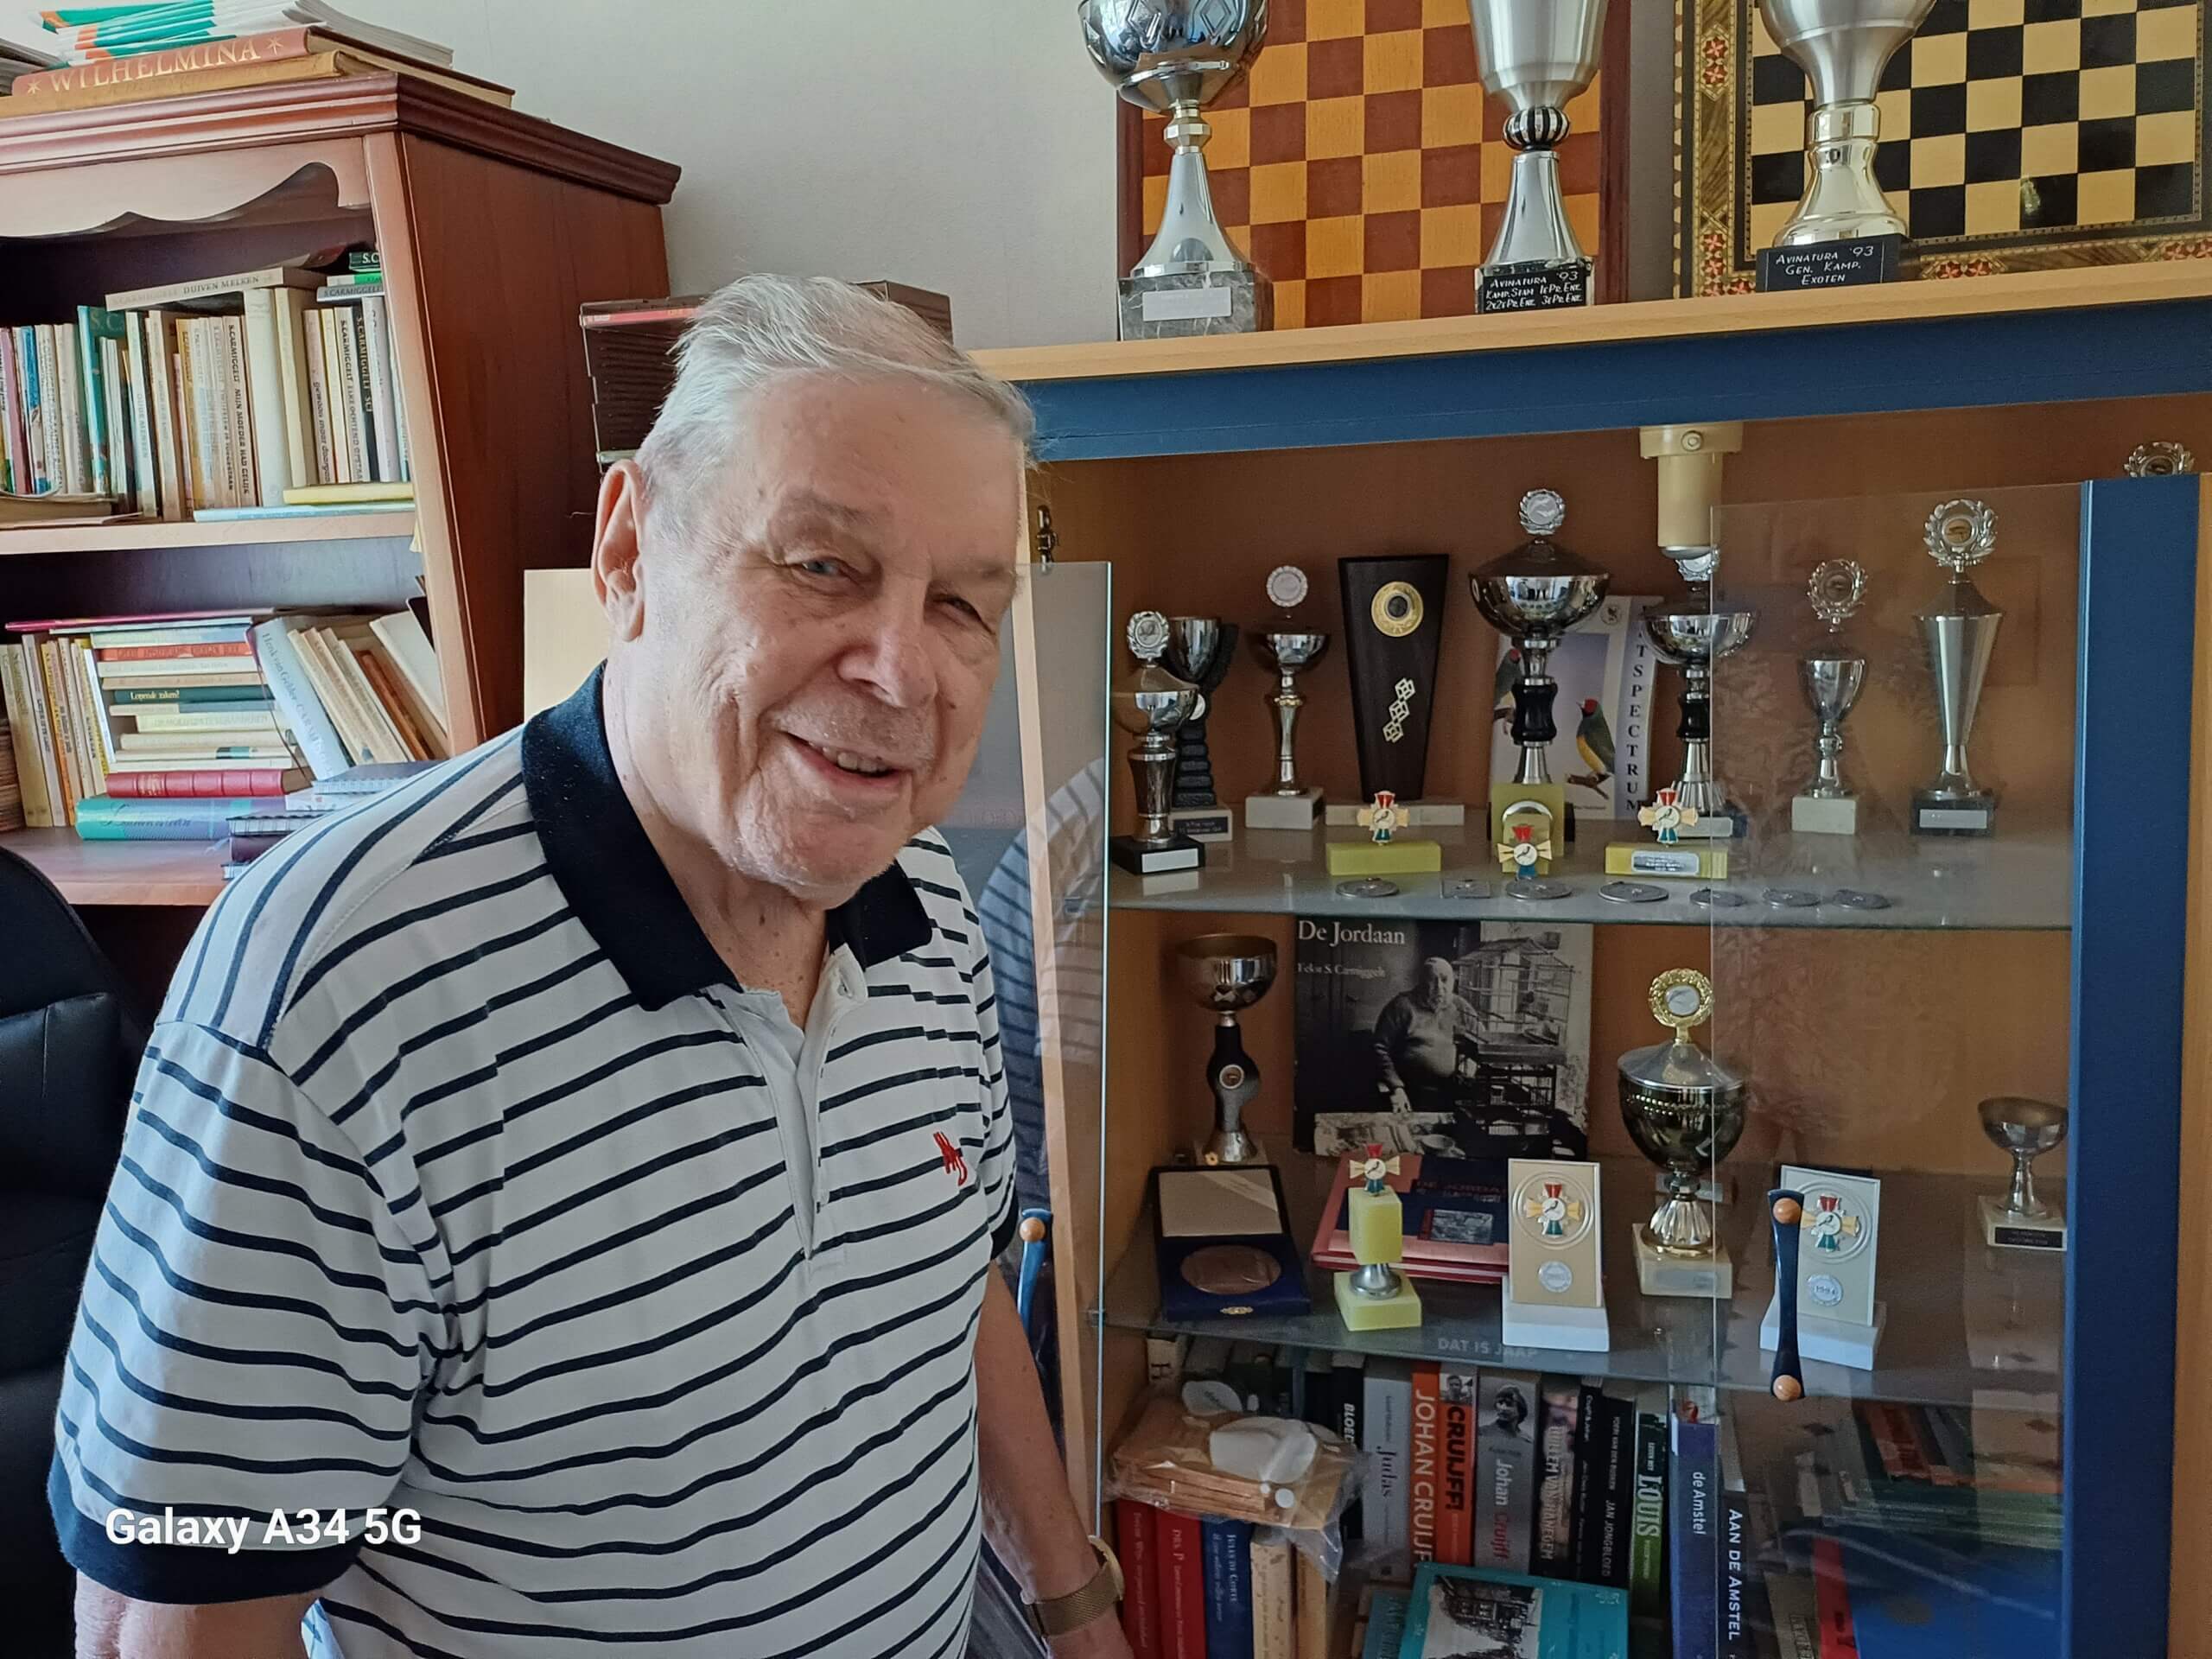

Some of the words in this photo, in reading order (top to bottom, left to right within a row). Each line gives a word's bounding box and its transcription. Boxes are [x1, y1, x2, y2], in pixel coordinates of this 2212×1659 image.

[50, 40, 261, 92] WILHELMINA
[1776, 251, 1838, 264] AVINATURA
[1823, 261, 1861, 272] KAMP.
[183, 281, 219, 295] DUIVEN
[220, 275, 259, 289] MELKEN
[1490, 276, 1547, 289] AVINATURA
[1801, 274, 1846, 286] EXOTEN
[1626, 631, 1649, 811] TSPECTRUM
[1298, 920, 1327, 941] De
[1329, 921, 1406, 947] Jordaan
[1438, 1338, 1470, 1351] DAT
[1414, 1389, 1435, 1476] JOHAN
[1376, 1446, 1398, 1498] Judas
[1445, 1406, 1466, 1511] CRUIJFF!
[1495, 1459, 1513, 1506] Johan
[1693, 1471, 1707, 1488] de
[1605, 1499, 1616, 1519] JAN
[1637, 1474, 1662, 1537] LOUIS
[1693, 1489, 1707, 1535] Amstel
[1413, 1482, 1435, 1566] CRUIJF
[1728, 1509, 1743, 1544] AAN
[1728, 1550, 1741, 1572] DE
[1728, 1575, 1743, 1641] AMSTEL
